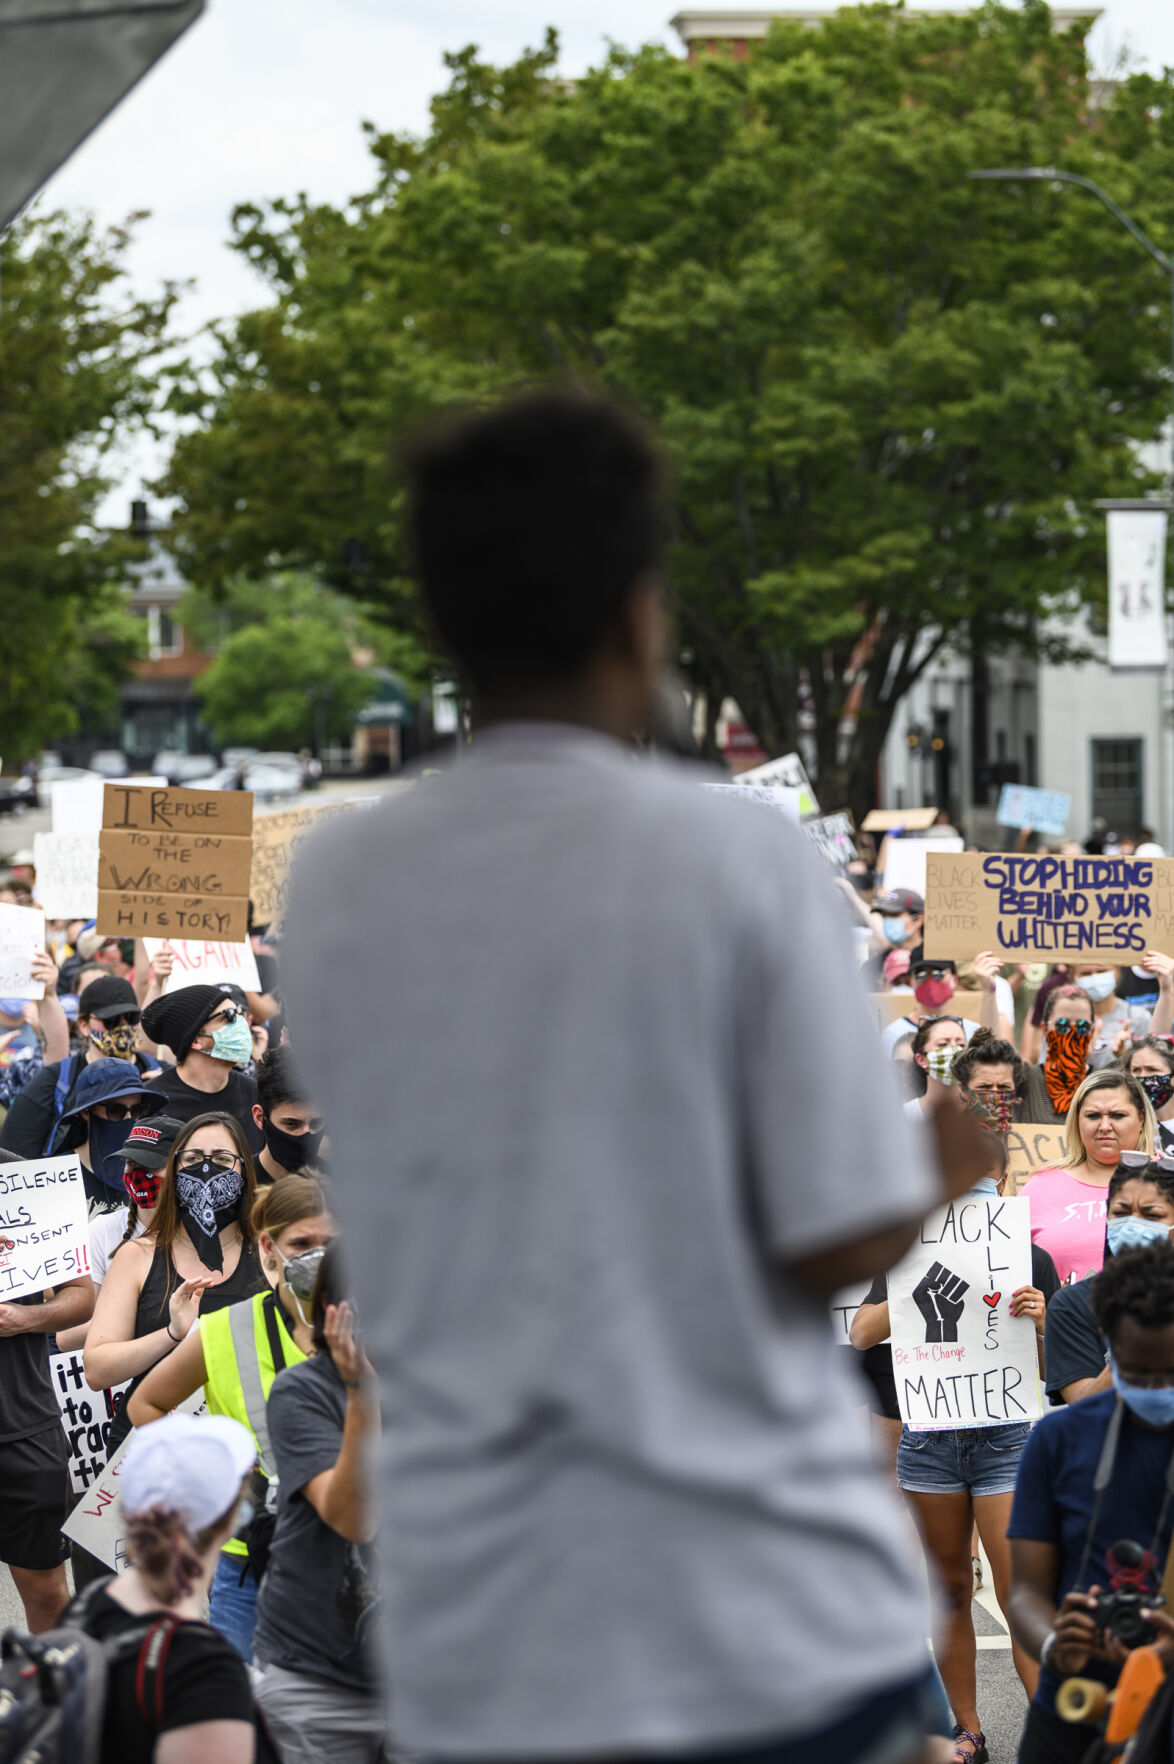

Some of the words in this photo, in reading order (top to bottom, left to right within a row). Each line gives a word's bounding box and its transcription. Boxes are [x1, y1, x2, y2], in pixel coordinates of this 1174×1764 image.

[114, 788, 142, 828] I
[151, 790, 219, 828] REFUSE
[128, 833, 149, 845] TO
[160, 835, 183, 846] BE
[194, 837, 222, 848] ON
[153, 848, 192, 863] THE
[110, 866, 222, 892] WRONG
[927, 864, 980, 888] BLACK
[121, 895, 167, 906] SIDE
[184, 898, 203, 907] OF
[927, 891, 977, 912] LIVES
[1095, 893, 1152, 920] YOUR
[118, 910, 230, 934] HISTORY!
[926, 914, 981, 931] MATTER
[997, 917, 1146, 950] WHITENESS
[0, 1168, 78, 1194] SILENCE
[894, 1347, 909, 1365] Be
[912, 1346, 929, 1361] The
[931, 1345, 966, 1362] Change
[905, 1366, 1027, 1420] MATTER
[63, 1397, 92, 1426] to
